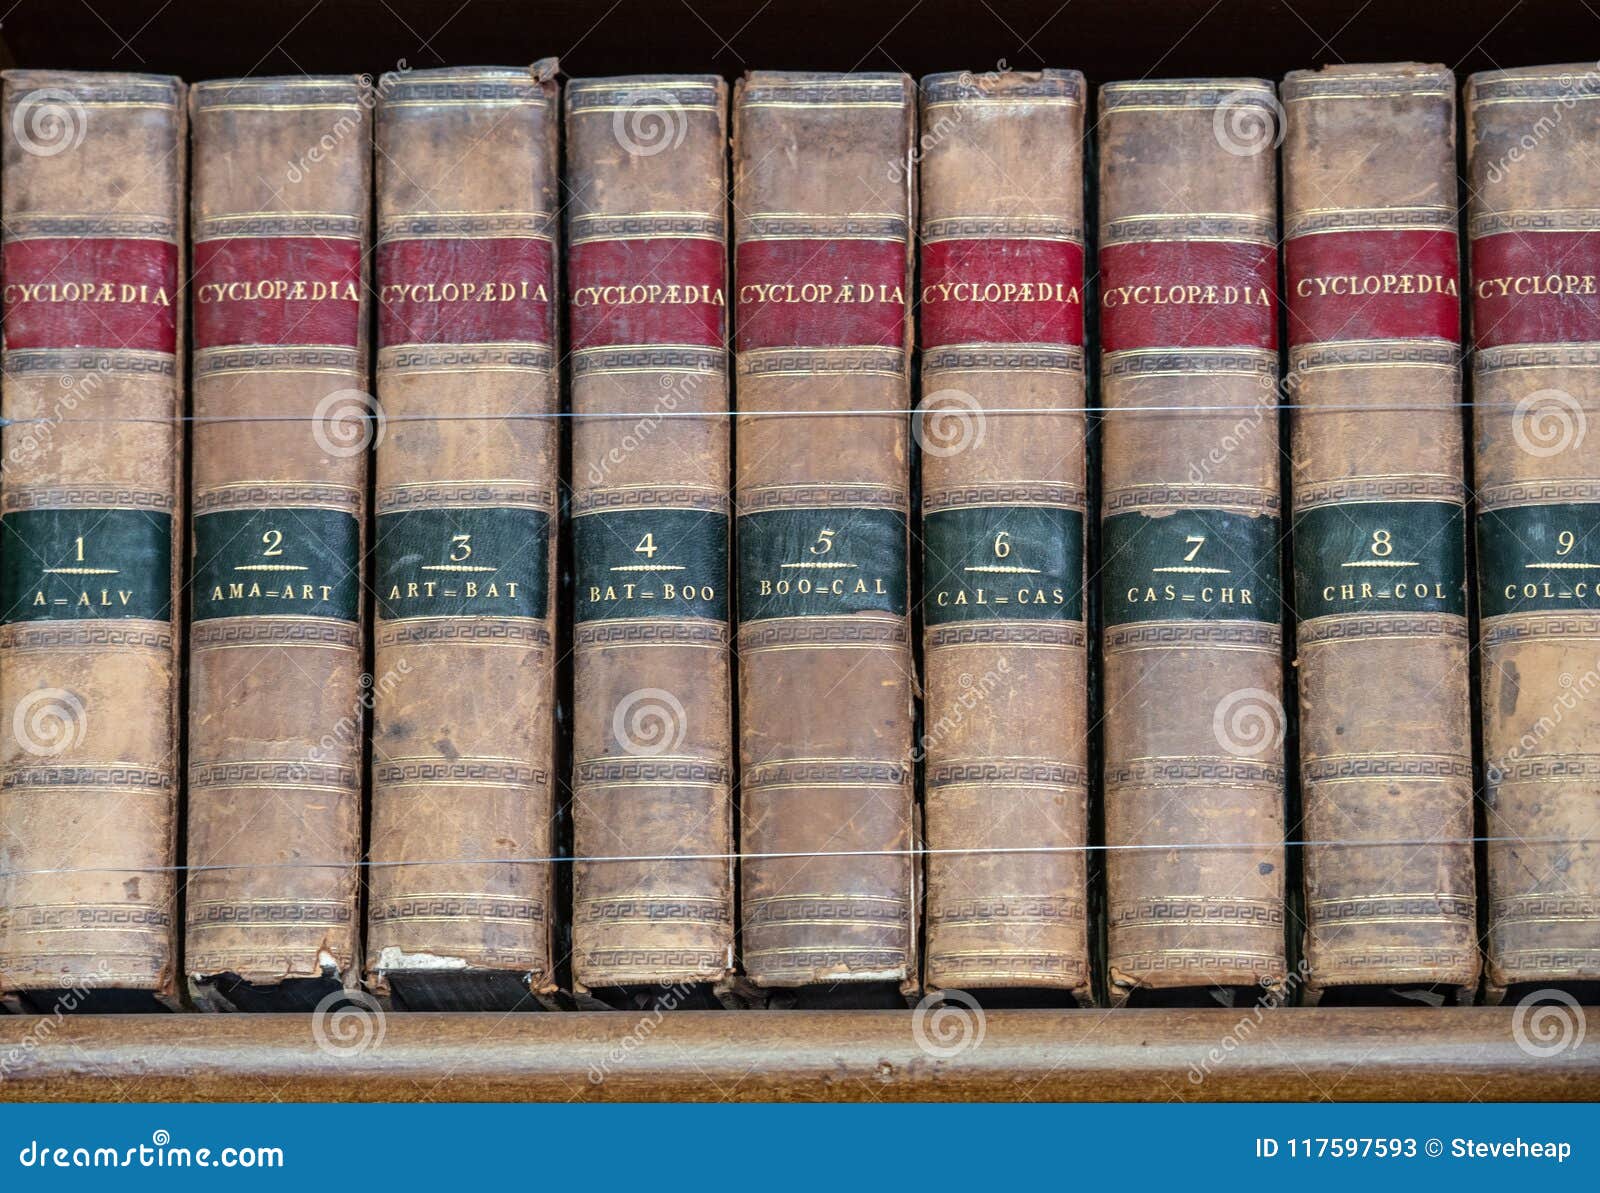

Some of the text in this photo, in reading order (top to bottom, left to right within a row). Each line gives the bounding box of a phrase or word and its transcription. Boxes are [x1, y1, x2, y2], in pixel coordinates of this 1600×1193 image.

[3, 282, 170, 306] CYCLOPÆDIA
[198, 280, 359, 304] CYCLOPÆDIA
[380, 281, 548, 304] CYCLOPÆDIA
[574, 284, 725, 307] CYCLOPÆDIA
[739, 283, 905, 305] CYCLOPÆDIA
[922, 282, 1080, 305] CYCLOPÆDIA
[1103, 285, 1271, 307] CYCLOPÆDIA
[1297, 275, 1458, 298] CYCLOPÆDIA
[74, 536, 86, 561] 1
[262, 530, 284, 557] 2
[450, 534, 472, 561] 3
[634, 533, 658, 559] 4
[810, 529, 836, 555] 5
[993, 531, 1010, 558] 6
[1183, 535, 1206, 562] 7
[1371, 529, 1393, 556] 8
[1556, 530, 1575, 555] 9
